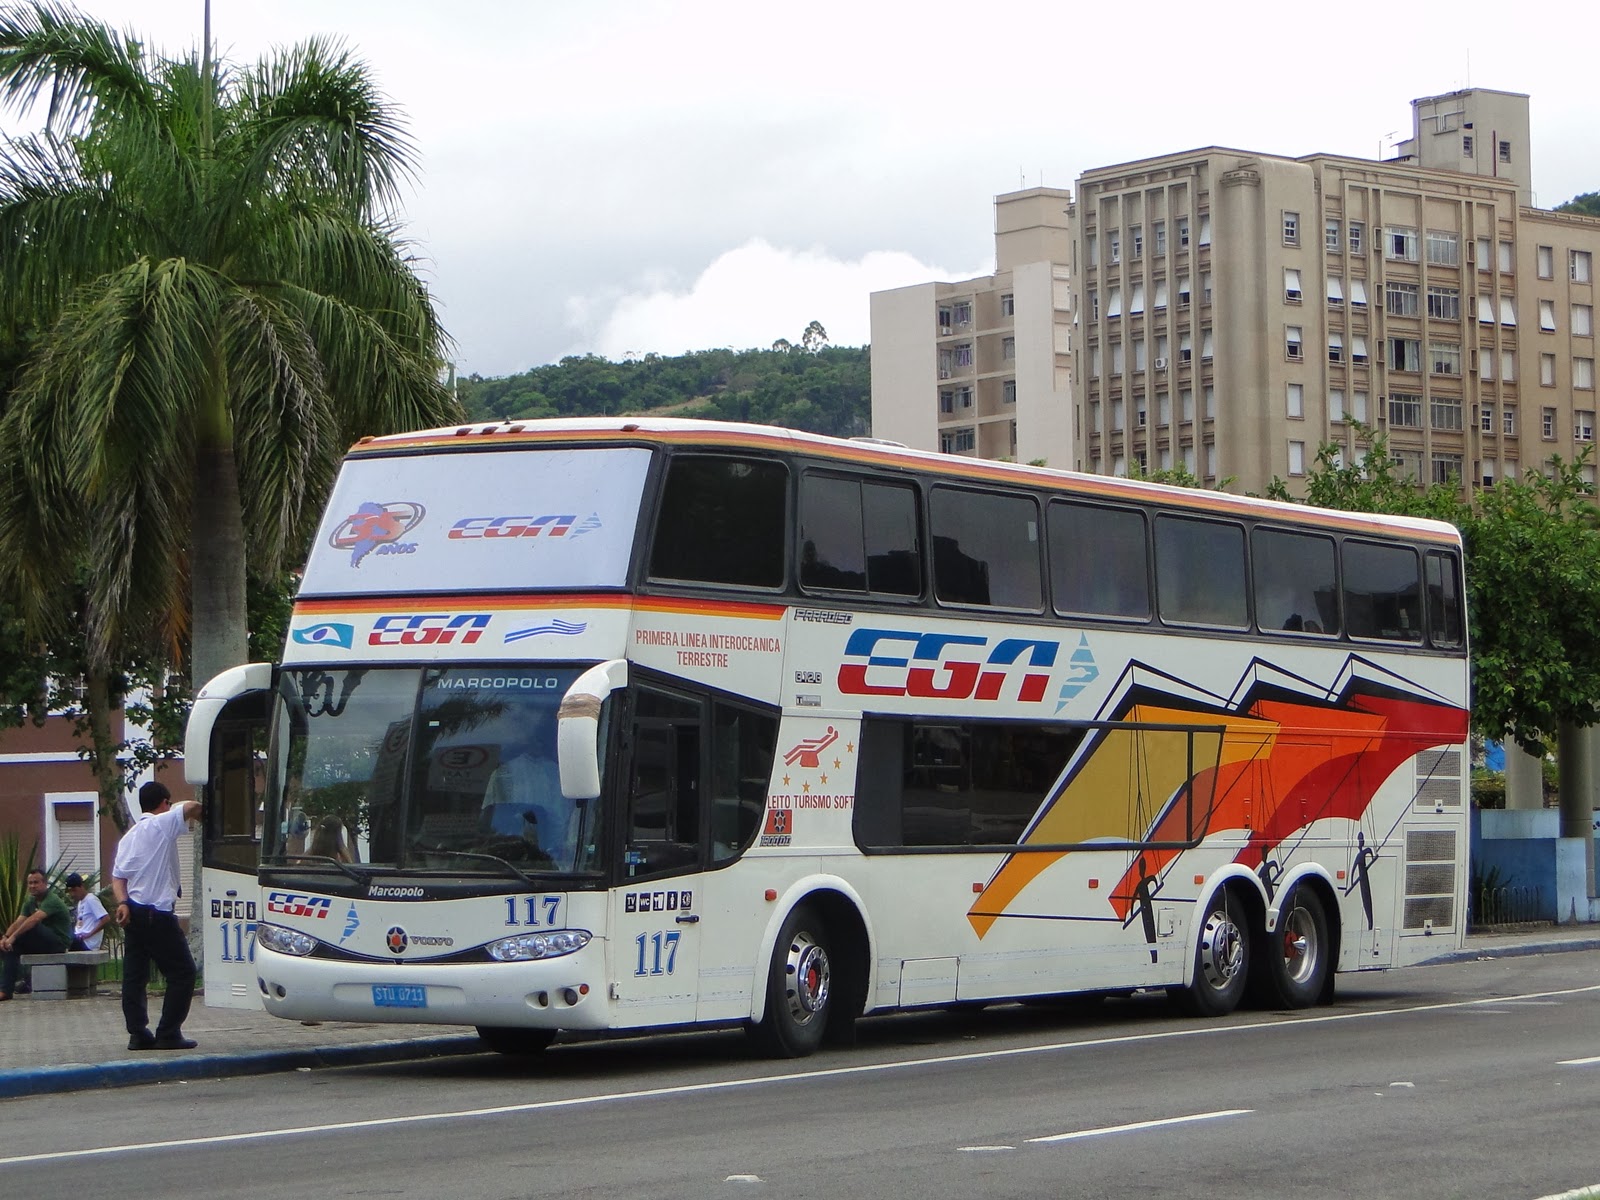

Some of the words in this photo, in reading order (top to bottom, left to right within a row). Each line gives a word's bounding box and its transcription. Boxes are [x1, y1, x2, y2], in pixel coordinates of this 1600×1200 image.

[447, 515, 577, 539] EGA
[794, 609, 853, 624] PARADISO
[368, 614, 493, 645] EGA
[636, 630, 679, 646] PRIMERA
[680, 632, 708, 648] LINEA
[709, 635, 781, 652] INTEROCEANICA
[677, 651, 729, 668] TERRESTRE
[837, 628, 1060, 702] EGA
[437, 677, 558, 689] MARCOPOLO
[767, 795, 791, 809] LEITO
[793, 795, 831, 809] TURISMO
[834, 795, 855, 809] SOFT
[368, 885, 424, 898] Marcopolo
[267, 892, 332, 919] EGA
[505, 896, 561, 926] 117
[220, 920, 259, 964] 117
[410, 936, 453, 946] VOLVO
[634, 930, 682, 977] 117
[375, 987, 395, 1001] STU
